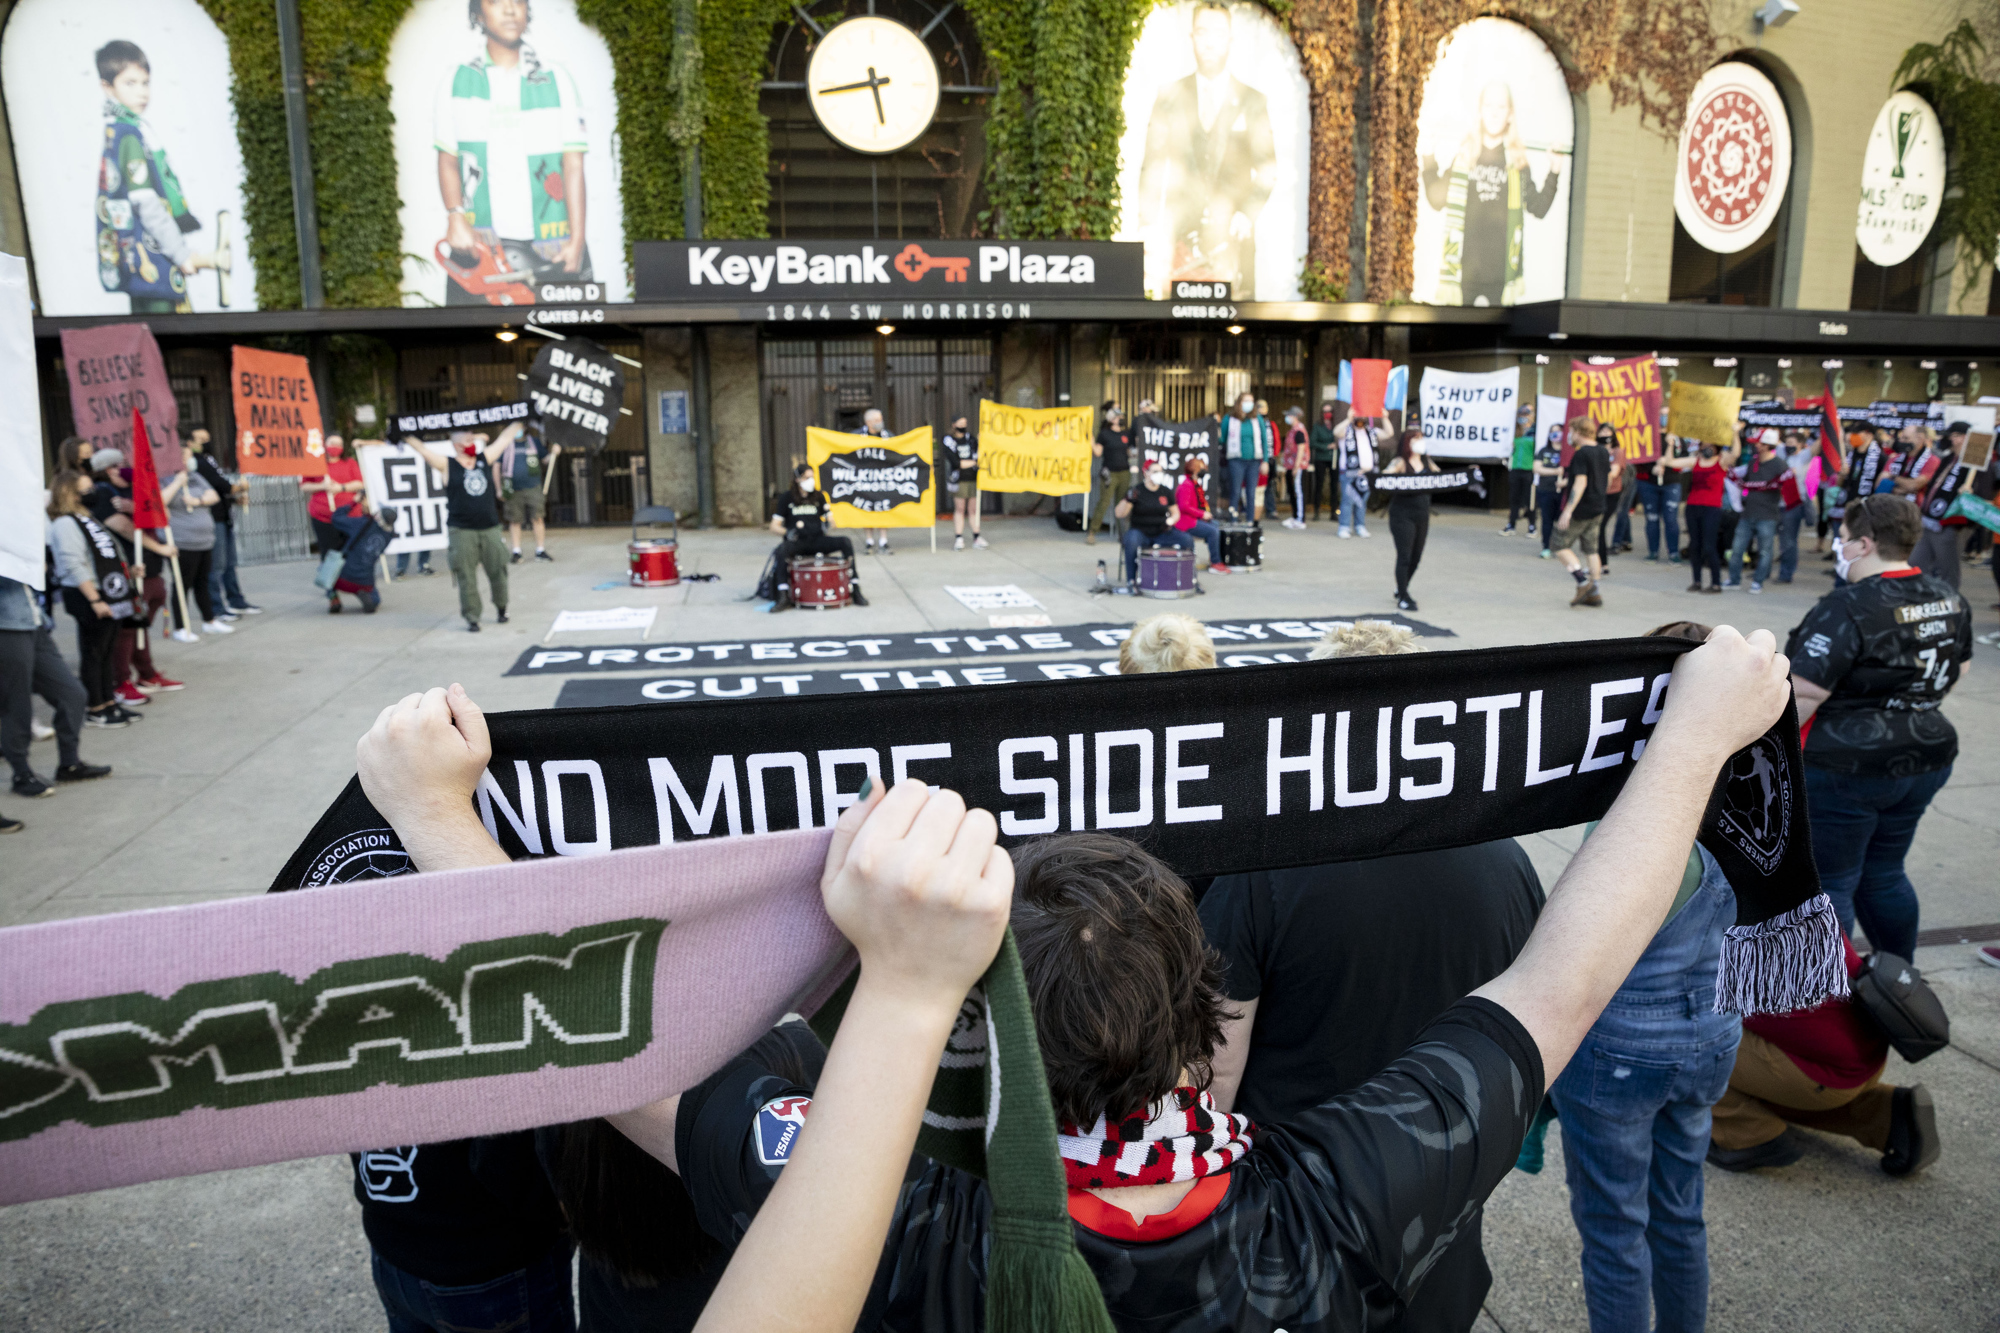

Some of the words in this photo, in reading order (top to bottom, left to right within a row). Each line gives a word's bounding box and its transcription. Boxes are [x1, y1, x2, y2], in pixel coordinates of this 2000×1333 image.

[1693, 93, 1771, 147] PORTLAND
[1691, 175, 1769, 223] THORNS
[1902, 193, 1928, 211] CUP
[688, 245, 891, 292] KeyBank
[979, 245, 1095, 283] Plaza
[541, 284, 583, 301] Gate
[585, 284, 600, 300] D
[1176, 282, 1213, 298] Gate
[1214, 283, 1227, 299] D
[537, 309, 580, 323] GATES
[580, 309, 604, 323] A-C
[766, 304, 831, 321] 1844
[850, 304, 882, 320] SW
[903, 303, 1031, 319] MORRISON
[1171, 305, 1207, 318] GATES
[78, 352, 145, 386] BELIEVE
[549, 347, 616, 387] BLACK
[1571, 358, 1661, 400] BELIEVE
[241, 372, 309, 402] BELIEVE
[547, 372, 605, 407] LIVES
[1488, 388, 1513, 403] UP
[251, 404, 305, 430] MANA
[398, 416, 418, 431] NO
[417, 412, 452, 430] MORE
[452, 410, 479, 427] SIDE
[479, 402, 529, 423] HUSTLES
[530, 390, 609, 435] MATTER
[980, 411, 1026, 436] HOLD
[1425, 405, 1463, 421] AND
[1588, 396, 1648, 429] NADIA
[255, 434, 304, 458] SHIM
[1142, 426, 1175, 448] THE
[1178, 431, 1210, 449] BAR
[832, 467, 919, 481] WILKINSON
[977, 451, 1088, 485] ACCOUNTABLE
[1902, 599, 1953, 621] FARRELLY
[1919, 620, 1947, 638] SHIM
[528, 638, 893, 669] PROTECT
[914, 632, 1073, 653] THE
[641, 674, 813, 700] CUT
[840, 665, 1018, 692] THE
[475, 759, 612, 857] NO
[1000, 722, 1224, 836] SIDE
[308, 834, 390, 888] ASSOCIATION
[774, 1122, 797, 1157] NWSL
